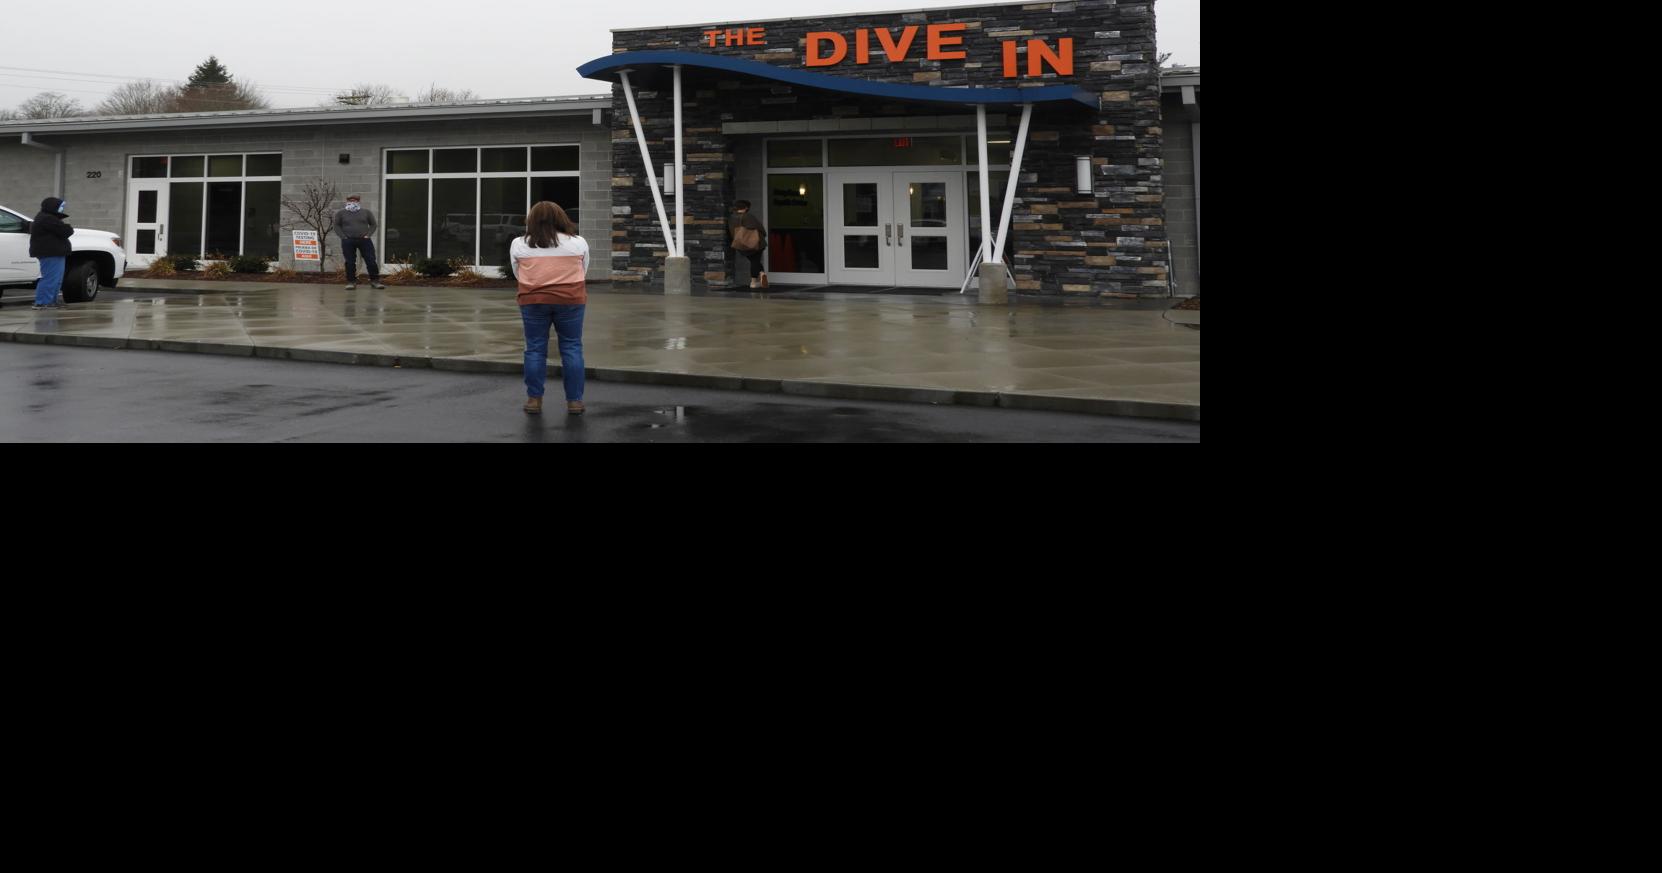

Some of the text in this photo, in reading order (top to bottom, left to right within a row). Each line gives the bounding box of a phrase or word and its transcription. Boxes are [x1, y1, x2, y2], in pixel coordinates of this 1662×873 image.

[704, 22, 1074, 78] THE DIVE IN
[86, 171, 102, 179] 220
